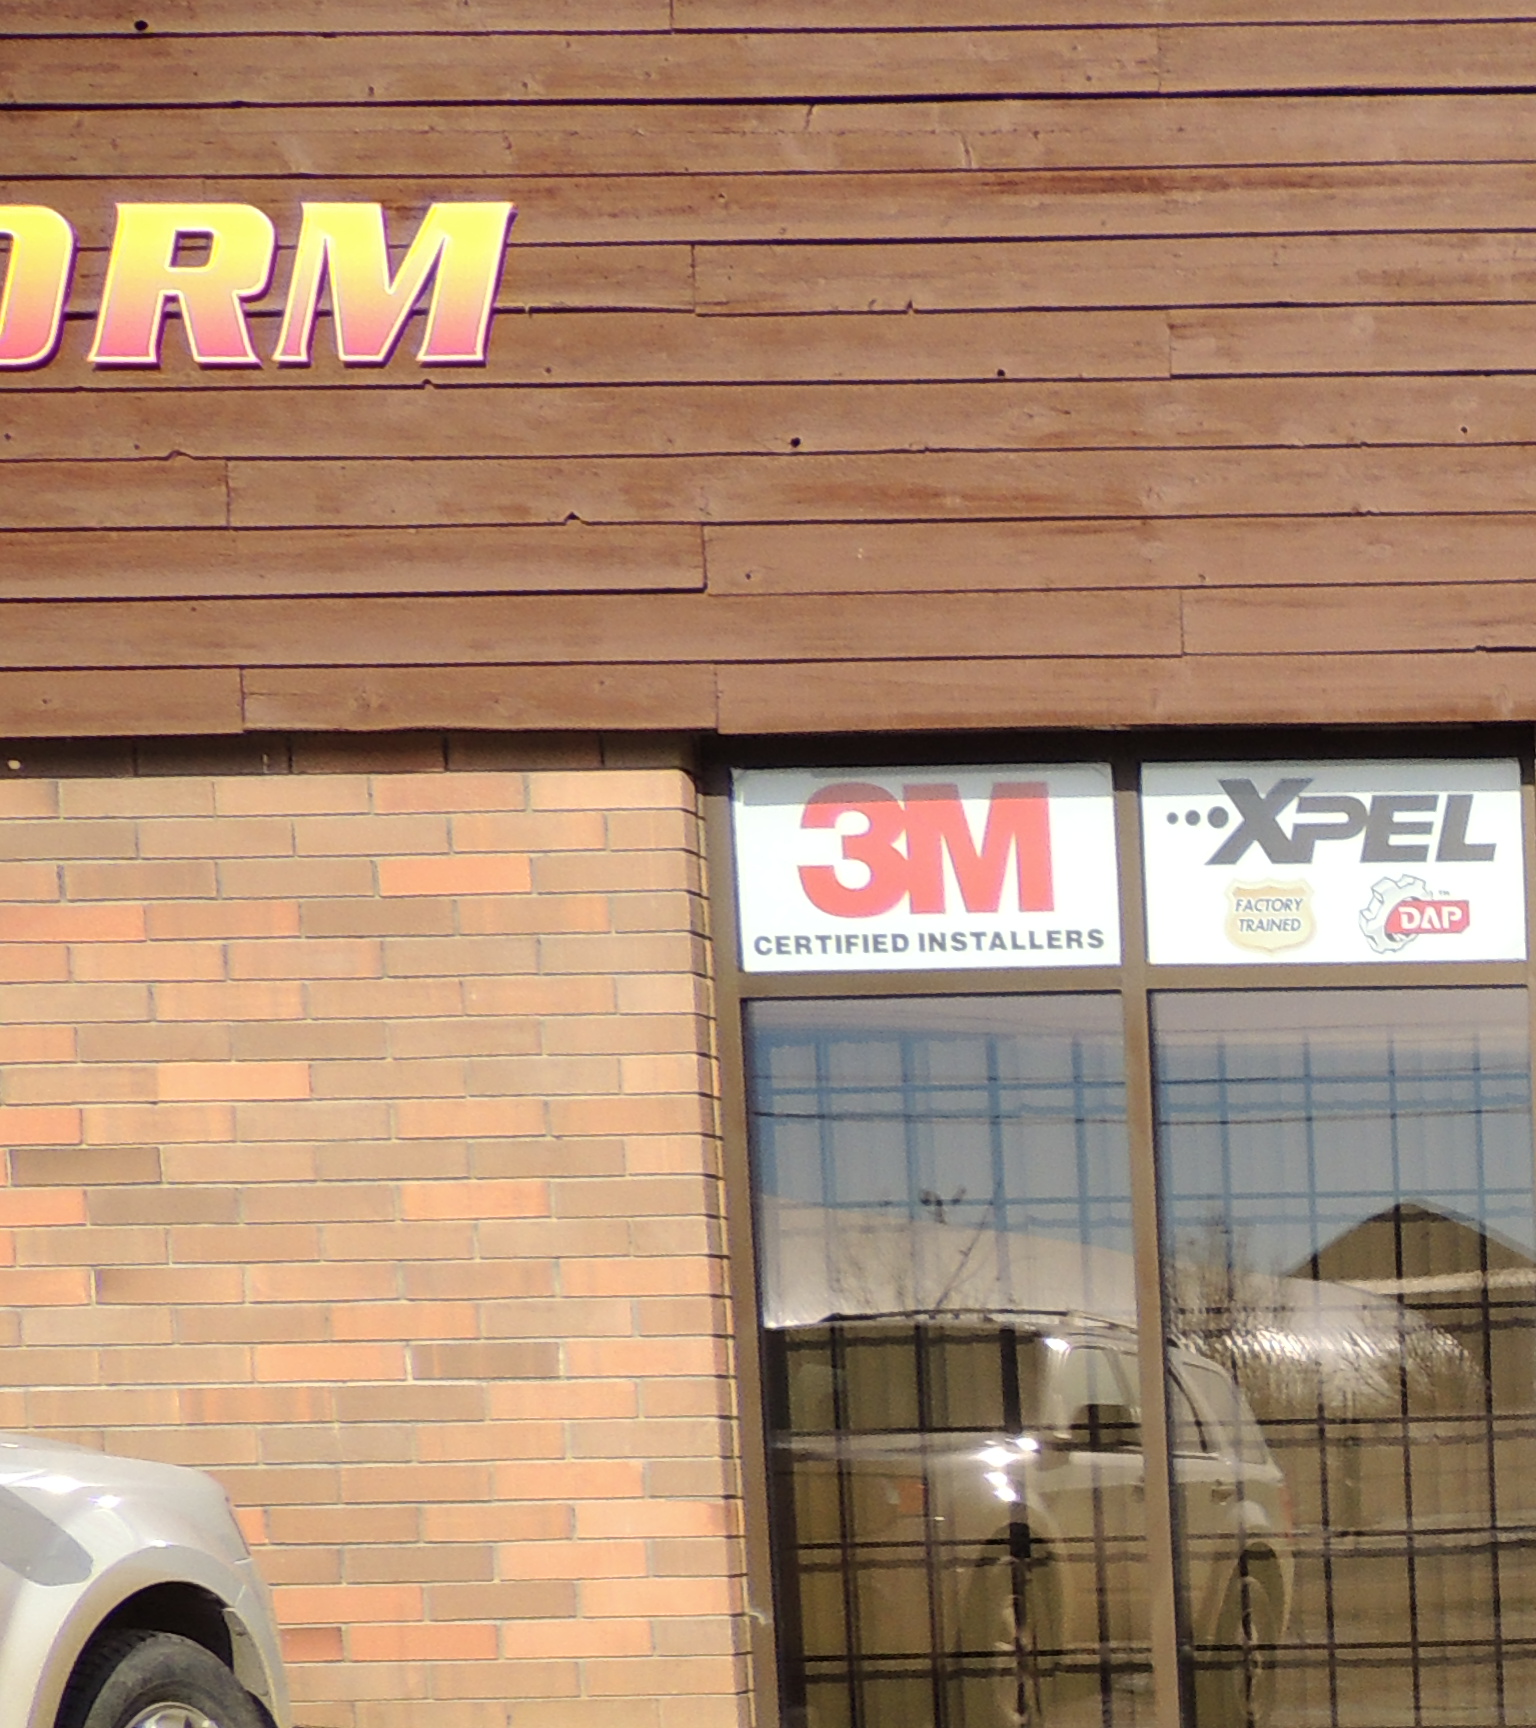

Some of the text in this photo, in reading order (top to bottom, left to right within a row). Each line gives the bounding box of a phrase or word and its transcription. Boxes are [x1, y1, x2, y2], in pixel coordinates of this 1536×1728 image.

[1204, 777, 1497, 865] XPEL
[797, 781, 1054, 918] 3M
[1235, 898, 1303, 913] FACTORY
[1400, 905, 1463, 930] DAP
[1239, 917, 1301, 933] TRAINED
[754, 929, 1105, 956] CERTIFIED INSTALLERS
